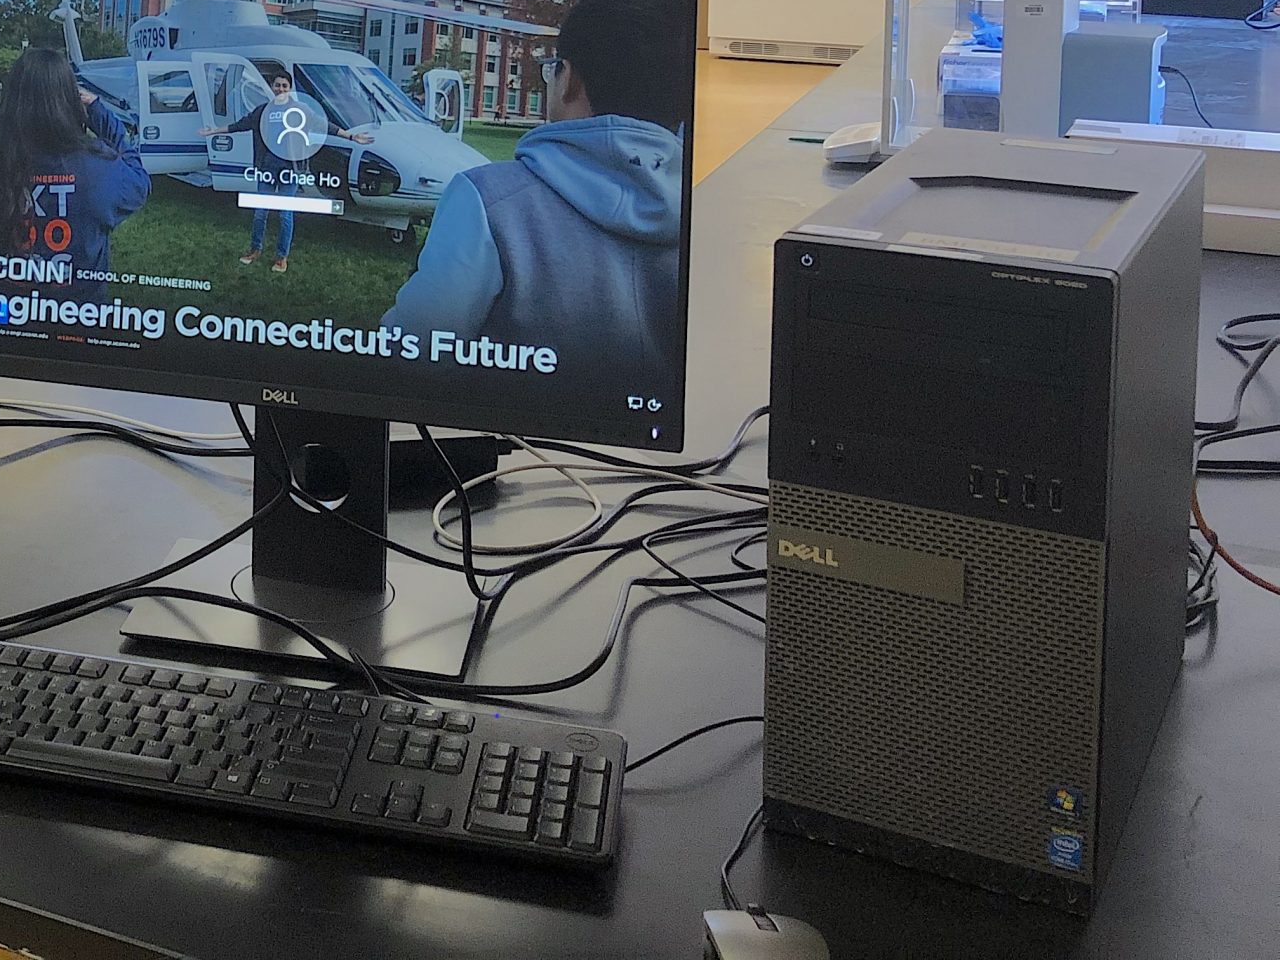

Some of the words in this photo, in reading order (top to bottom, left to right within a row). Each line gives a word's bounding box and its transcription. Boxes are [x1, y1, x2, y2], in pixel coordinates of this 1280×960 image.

[243, 167, 275, 185] Cho,
[279, 169, 316, 186] Chae
[319, 172, 341, 188] Ho
[76, 269, 119, 283] SCHOOL
[121, 273, 136, 284] OF
[138, 275, 212, 291] ENGINEERING
[175, 305, 420, 361] Connecticut's
[430, 330, 558, 374] Future
[262, 388, 299, 405] DELL
[778, 539, 839, 568] DELL
